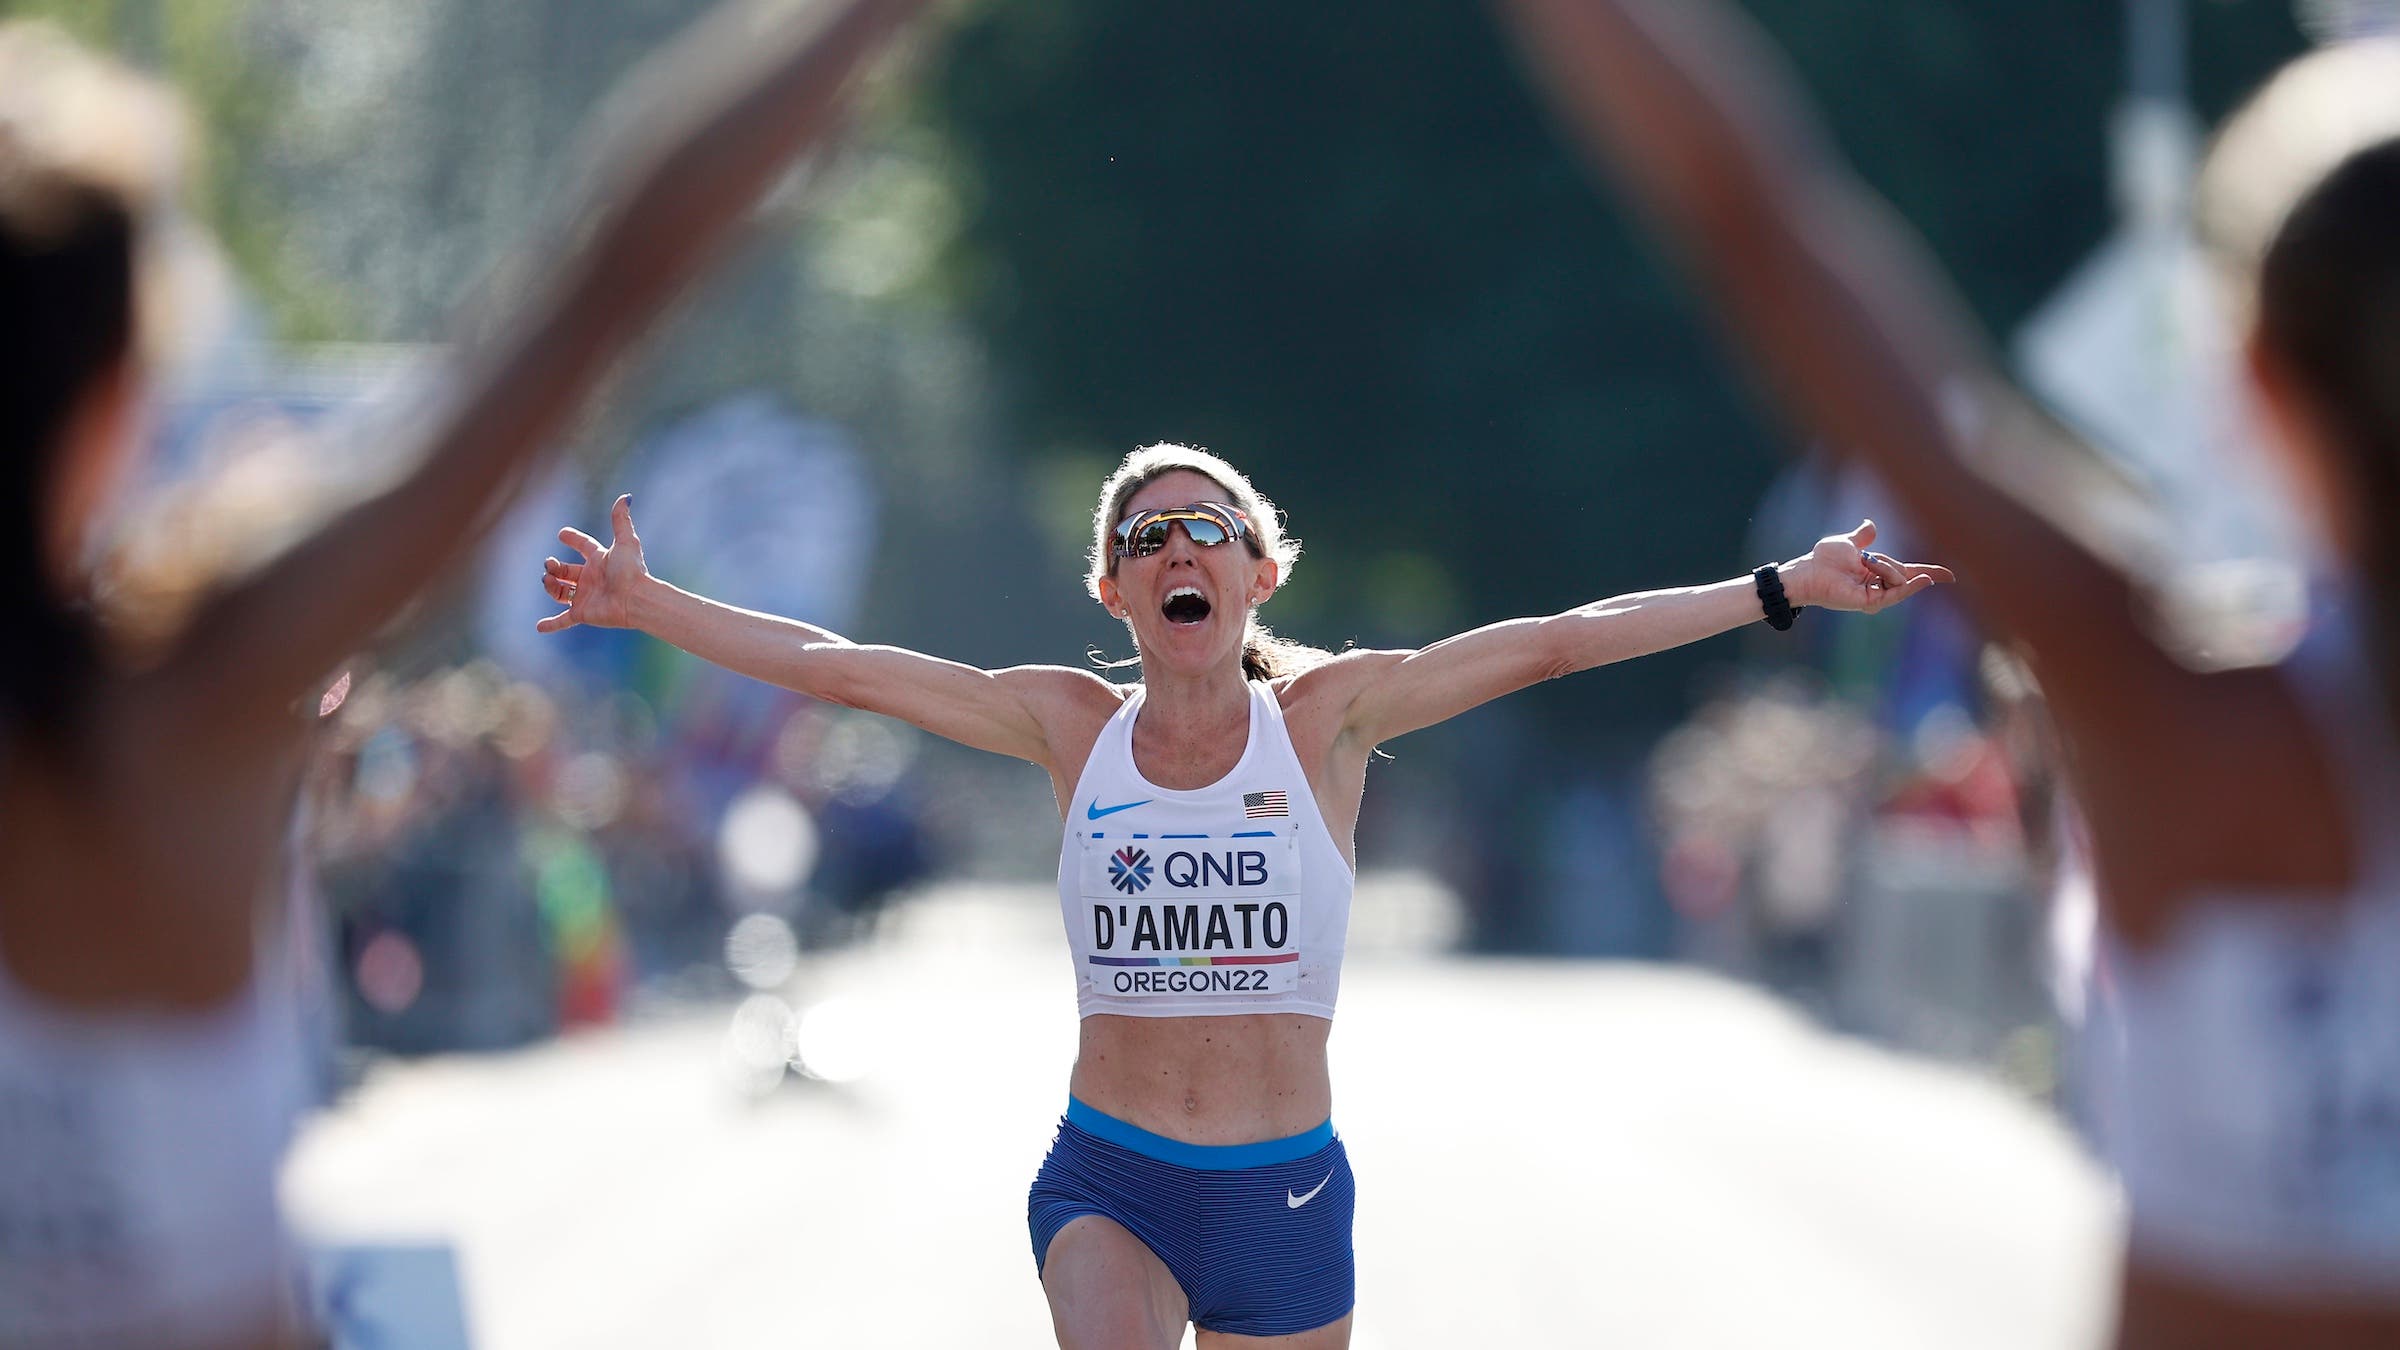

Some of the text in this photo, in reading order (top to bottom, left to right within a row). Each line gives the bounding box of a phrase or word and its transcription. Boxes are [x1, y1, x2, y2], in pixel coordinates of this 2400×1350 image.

[1164, 851, 1268, 888] QNB
[1094, 902, 1288, 951] D'AMATO
[1114, 969, 1269, 993] OREGON22
